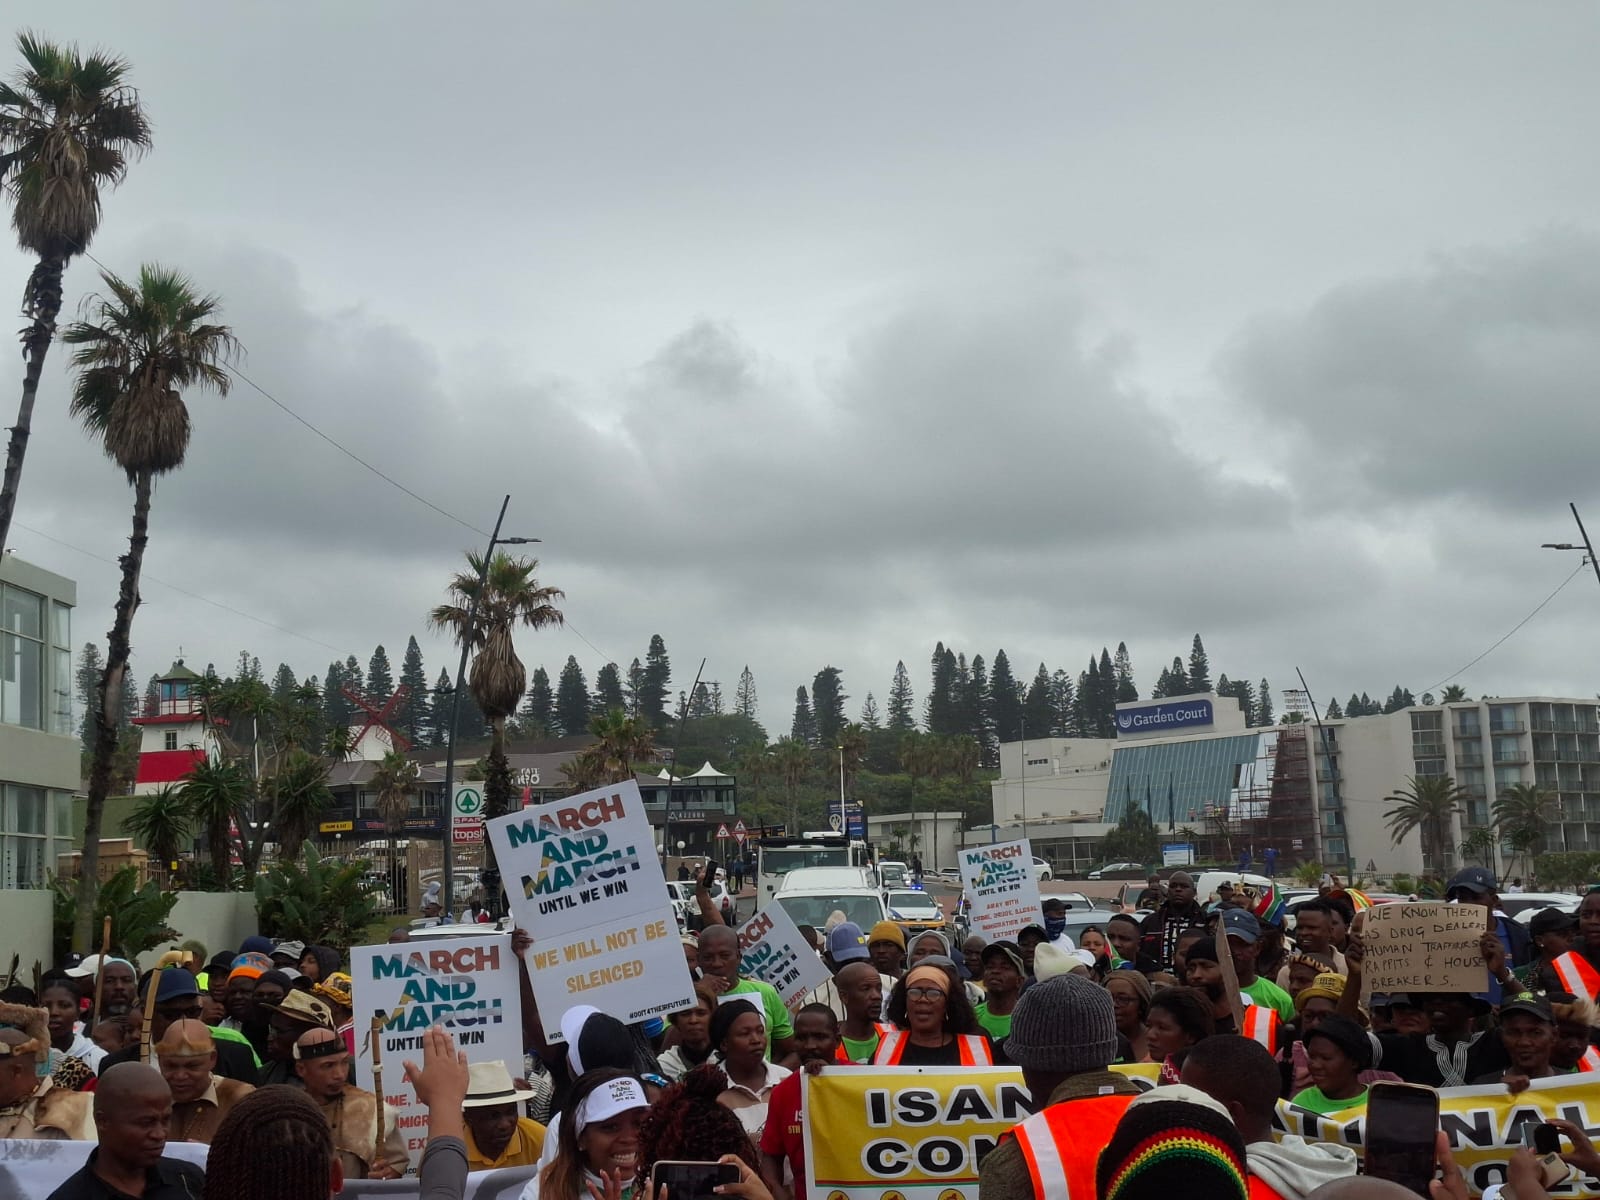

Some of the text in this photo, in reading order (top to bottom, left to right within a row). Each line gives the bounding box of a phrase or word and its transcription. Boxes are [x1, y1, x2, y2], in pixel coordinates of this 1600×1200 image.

[1133, 706, 1208, 726] Garden Court
[505, 793, 626, 849] MARCH
[453, 828, 484, 841] tops!
[541, 828, 609, 869] AND
[966, 845, 1022, 865] MARCH
[520, 845, 641, 900] MARCH
[981, 860, 1014, 876] AND
[971, 869, 1027, 889] MARCH
[538, 879, 628, 915] UNTIL WE WIN
[977, 889, 996, 897] UNTIL
[998, 885, 1008, 893] WE
[1368, 906, 1479, 922] WE KNOW THEM
[737, 912, 774, 950] RCH
[1364, 928, 1380, 940] AS
[1390, 926, 1425, 939] DRUG
[533, 920, 668, 971] WE WILL NOT BE
[1364, 943, 1412, 957] HUMAN
[371, 944, 500, 981] MARCH
[1444, 957, 1486, 969] HOUSE
[566, 959, 644, 994] SILENCED
[782, 966, 801, 985] WIN
[398, 975, 476, 1005] AND
[374, 998, 502, 1034] MARCH
[459, 1030, 485, 1045] WIN
[870, 1086, 1032, 1124] ISAN
